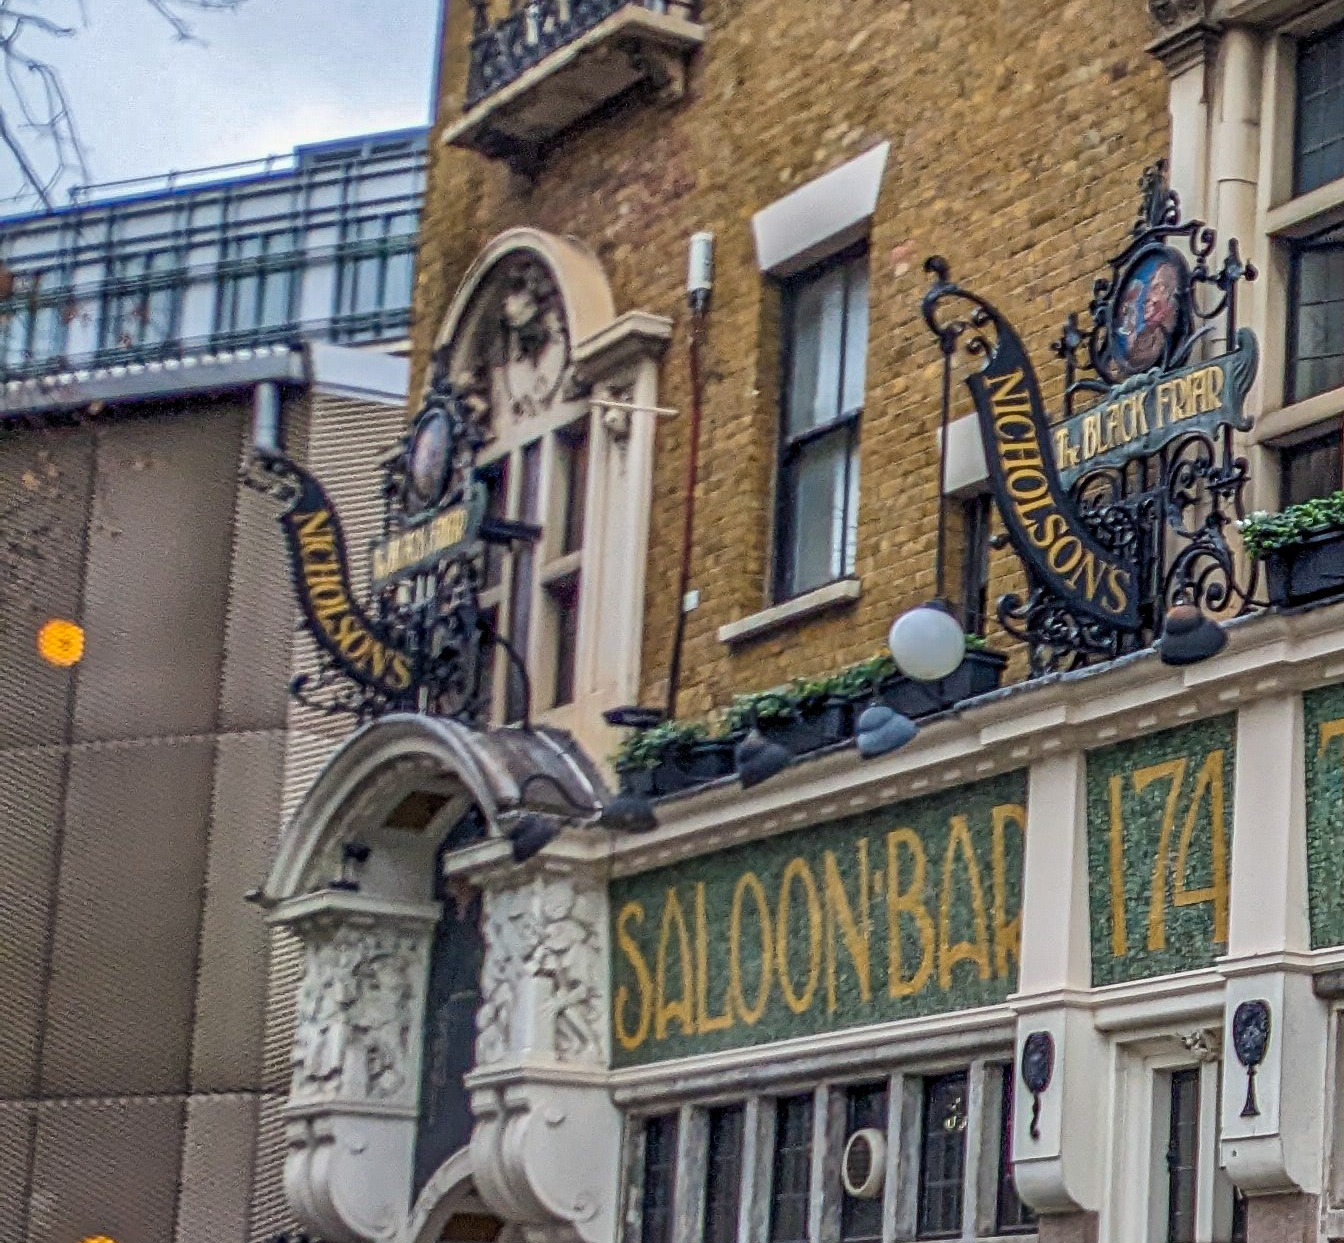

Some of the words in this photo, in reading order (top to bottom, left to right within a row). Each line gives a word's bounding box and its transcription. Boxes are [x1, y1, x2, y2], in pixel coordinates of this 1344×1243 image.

[1082, 391, 1149, 461] BLACK
[1156, 366, 1225, 428] FRIAR
[614, 836, 872, 1050] SALOON
[886, 803, 1026, 998] BAR
[1108, 749, 1230, 957] 174
